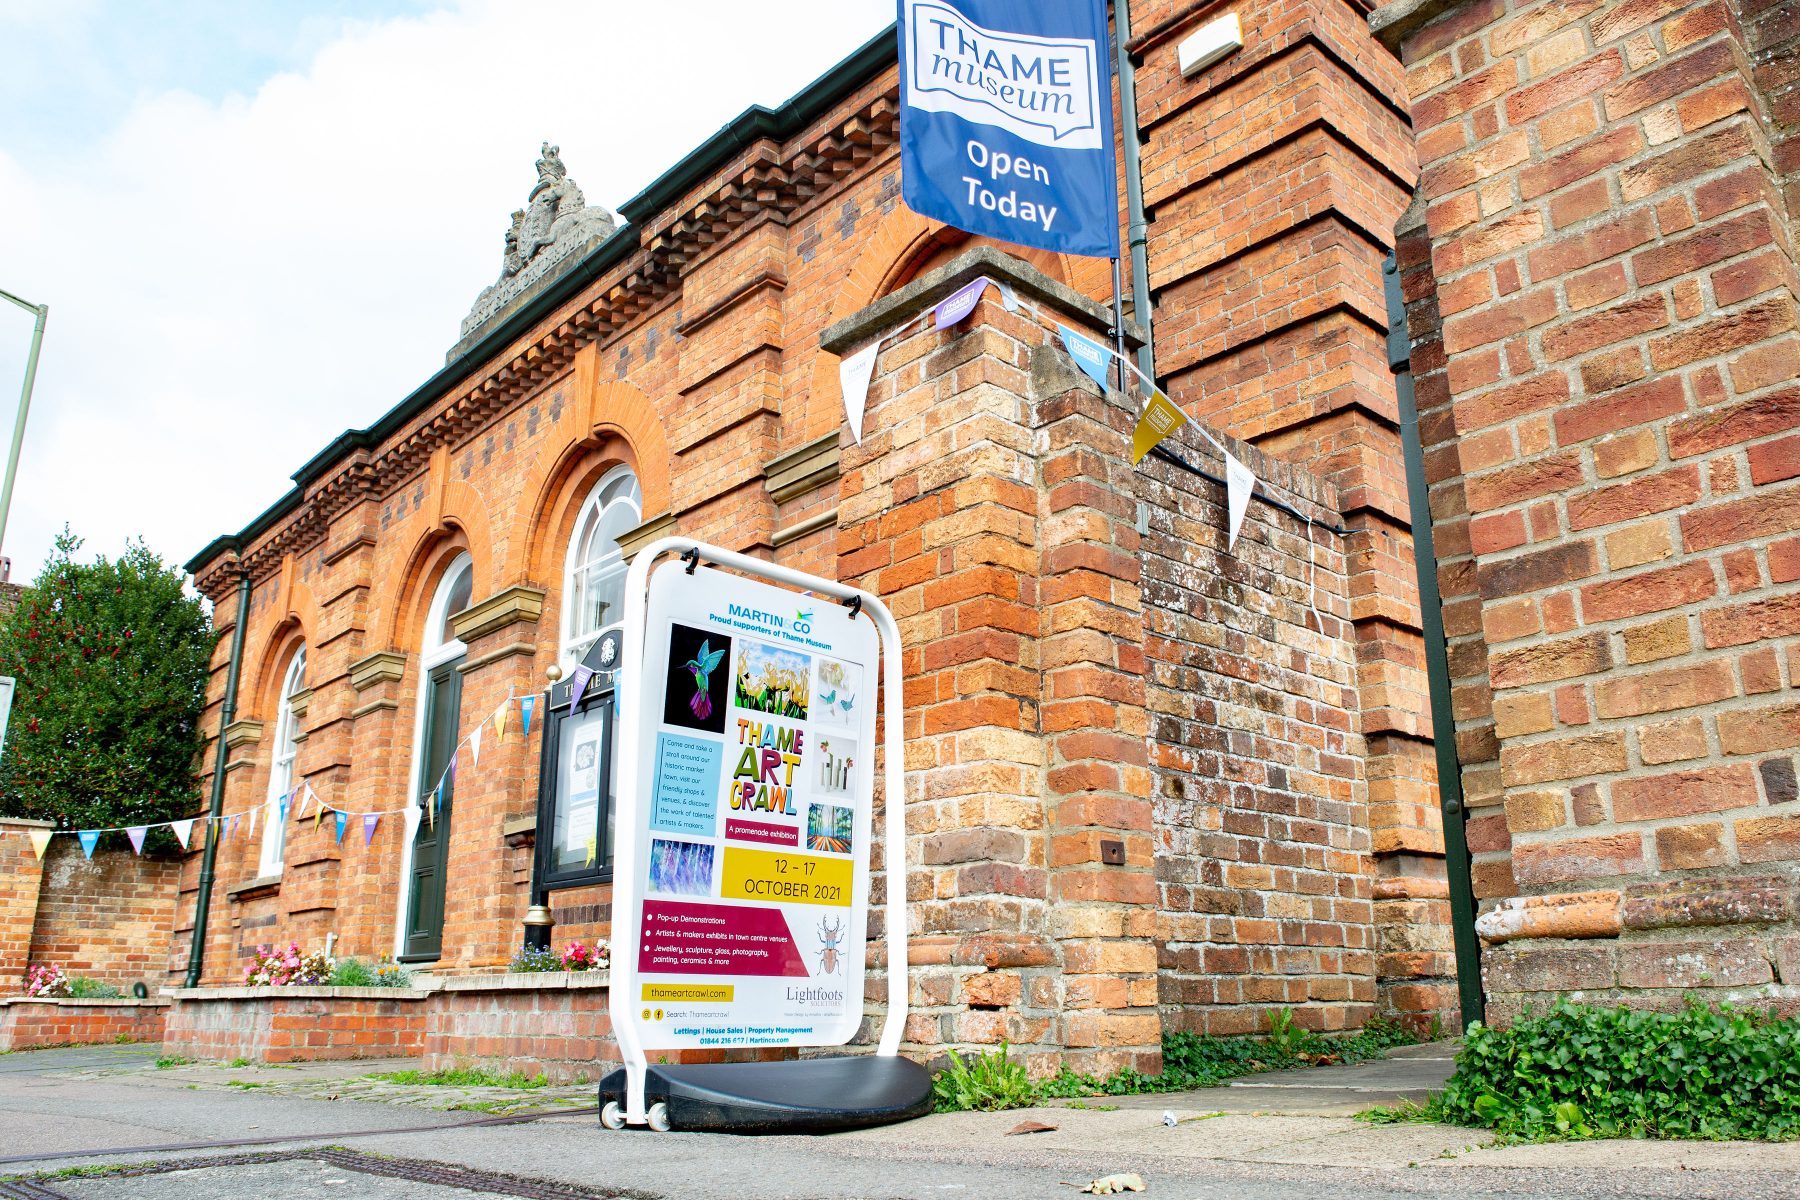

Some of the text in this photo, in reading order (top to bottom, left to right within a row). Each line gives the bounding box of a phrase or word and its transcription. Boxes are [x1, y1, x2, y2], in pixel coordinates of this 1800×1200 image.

[930, 18, 1071, 87] THAME
[932, 53, 1075, 115] museum
[966, 140, 1050, 186] Open
[962, 176, 1057, 232] Today
[1154, 407, 1172, 426] THAME
[727, 603, 783, 628] MARTIN
[793, 621, 811, 635] CO
[708, 613, 832, 650] Proud supporters of Thame Museum
[667, 739, 683, 748] Come
[738, 718, 803, 755] THAME
[681, 754, 700, 762] around
[665, 762, 684, 770] historic
[733, 746, 801, 787] ART
[662, 784, 682, 794] friendly
[684, 788, 699, 796] shops
[688, 799, 711, 808] discover
[730, 780, 797, 816] CRAWL
[693, 811, 715, 820] talented
[735, 826, 769, 837] promenade
[770, 830, 797, 840] exhibition
[775, 859, 788, 873] 12
[803, 862, 816, 876] 17
[744, 879, 841, 900] OCTOBER 2021
[657, 914, 726, 925] Pop-up Demonstrations
[655, 929, 675, 938] Artists
[682, 930, 704, 939] makers
[706, 932, 727, 940] exhibits
[735, 933, 750, 941] town
[750, 934, 768, 942] centre
[769, 935, 788, 943] venues
[654, 944, 683, 954] Jewellery,
[685, 945, 713, 955] sculpture,
[732, 948, 768, 958] photography,
[680, 956, 707, 964] ceramics
[651, 988, 727, 998] thameartcrawl.com
[786, 987, 843, 1004] Lightfoots
[666, 1010, 687, 1018] Search:
[689, 1010, 730, 1018] Thameartcrawl
[674, 1027, 701, 1036] Lettings
[706, 1027, 726, 1035] House
[727, 1026, 743, 1034] Sales
[748, 1026, 775, 1035] Property
[776, 1026, 813, 1035] Management
